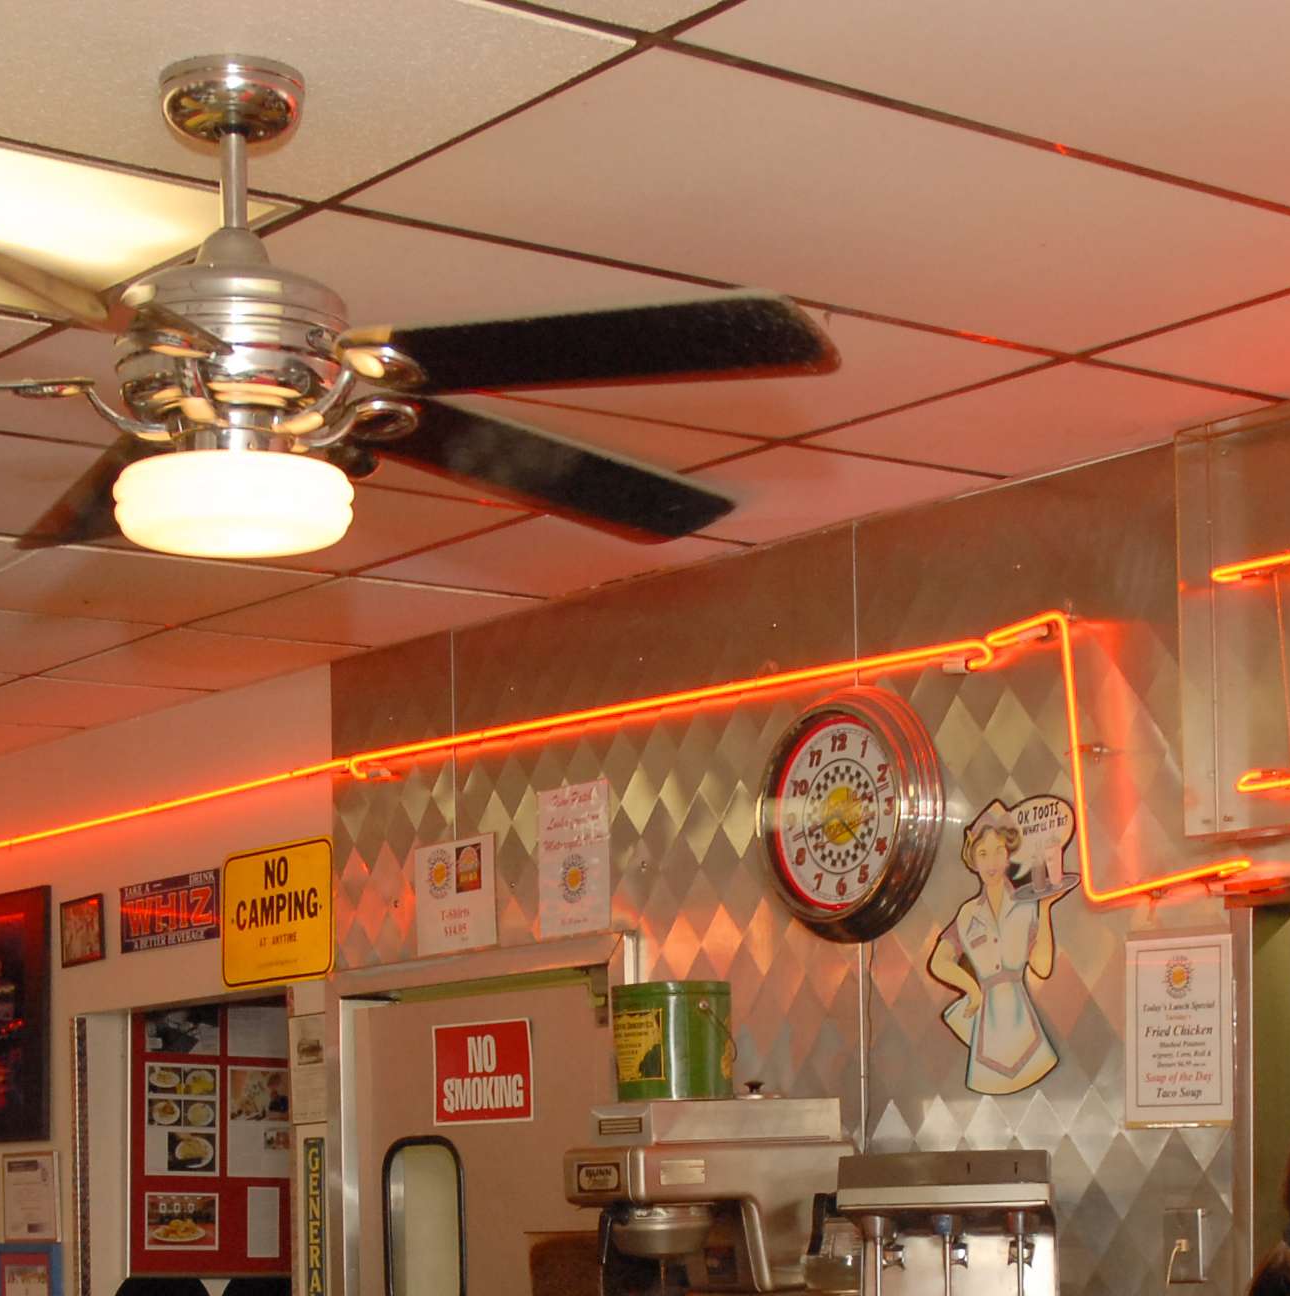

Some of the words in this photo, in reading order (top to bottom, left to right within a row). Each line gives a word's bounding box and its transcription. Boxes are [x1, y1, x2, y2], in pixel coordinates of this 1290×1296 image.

[830, 733, 847, 752] 12
[860, 735, 869, 758] 1
[809, 749, 824, 768] 11
[877, 763, 890, 783] 2
[791, 779, 810, 797] 10
[883, 795, 895, 817] 3
[1017, 810, 1030, 825] OK
[874, 836, 888, 856] 4
[794, 847, 806, 866] 8
[264, 855, 289, 890] NO
[813, 872, 824, 891] 7
[858, 863, 870, 884] 5
[836, 876, 847, 897] 6
[122, 886, 213, 938] WHIZ
[236, 887, 318, 932] CAMPING
[1168, 1002, 1190, 1011] Lunch
[1191, 1000, 1215, 1011] Special
[1144, 1025, 1171, 1038] Fried
[1173, 1023, 1213, 1037] Chicken
[467, 1034, 497, 1074] NO
[1145, 1072, 1167, 1084] Soup
[1167, 1071, 1178, 1084] of
[1179, 1071, 1194, 1081] the
[1195, 1071, 1213, 1083] Day
[443, 1074, 524, 1114] SMOKING
[1156, 1087, 1177, 1098] Taco
[1179, 1086, 1203, 1099] Soup
[584, 1167, 612, 1178] BUNN
